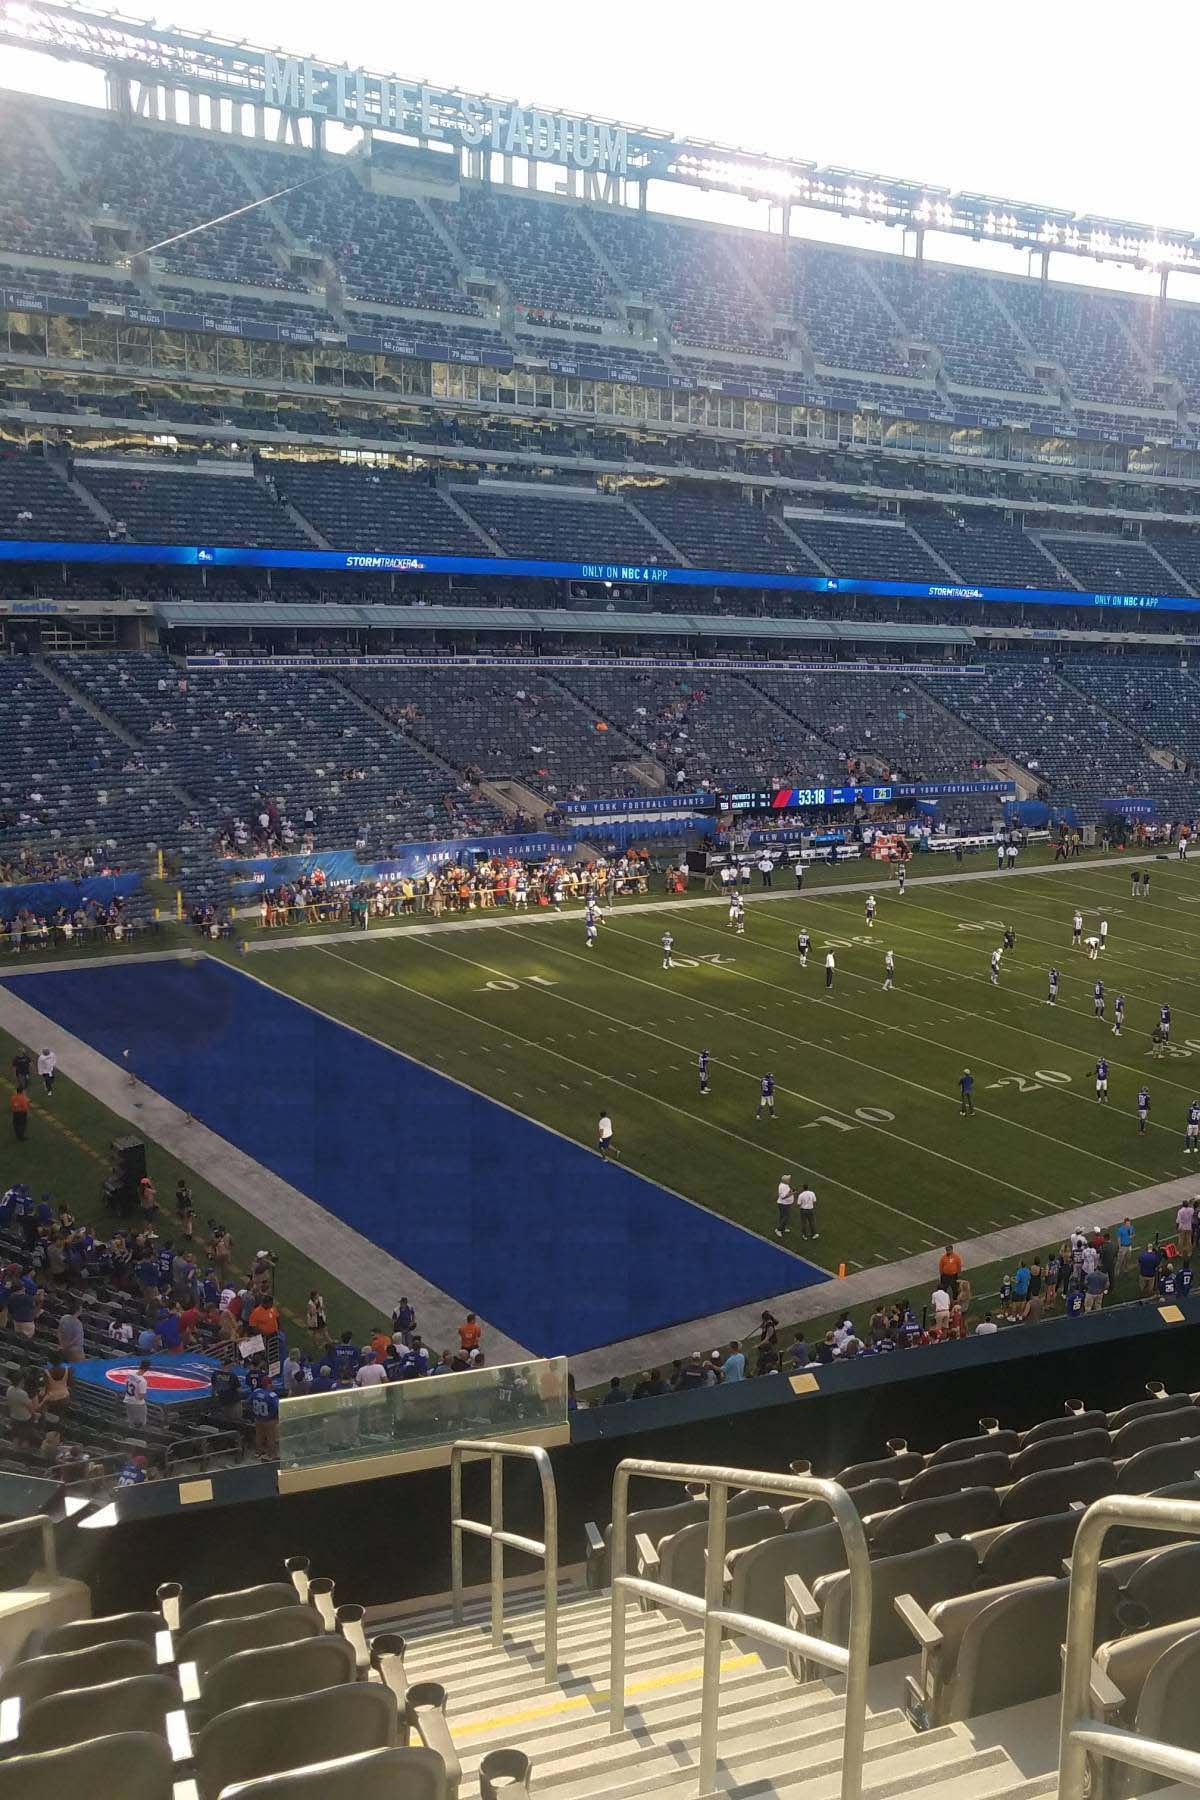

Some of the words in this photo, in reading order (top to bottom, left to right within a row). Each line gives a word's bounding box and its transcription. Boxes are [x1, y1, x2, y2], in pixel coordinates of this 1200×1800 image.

[263, 51, 445, 139] METLIFE
[459, 97, 628, 174] STADIUM
[582, 565, 604, 577] ONLY
[606, 566, 618, 578] ON
[621, 568, 640, 579] NBC
[643, 569, 649, 579] 4
[651, 569, 668, 580] APP
[12, 602, 58, 614] MetLife
[1094, 594, 1111, 605] ONLY
[1112, 596, 1122, 606] ON
[1123, 596, 1138, 606] NBC
[1139, 597, 1146, 607] 4
[1146, 598, 1159, 607] APP
[900, 788, 916, 796] NEW
[920, 786, 939, 794] YORK
[943, 784, 979, 793] FOOTBALL
[982, 782, 1008, 791] GIANTS
[798, 789, 825, 805] 53:18
[567, 805, 588, 813] NEW
[593, 803, 618, 812] YORK
[622, 800, 668, 810] FOOTBALL
[672, 798, 706, 807] GIANTS
[759, 833, 778, 841] NEW
[485, 974, 559, 993] 10
[1000, 1069, 1073, 1093] 20
[814, 1106, 896, 1133] 10
